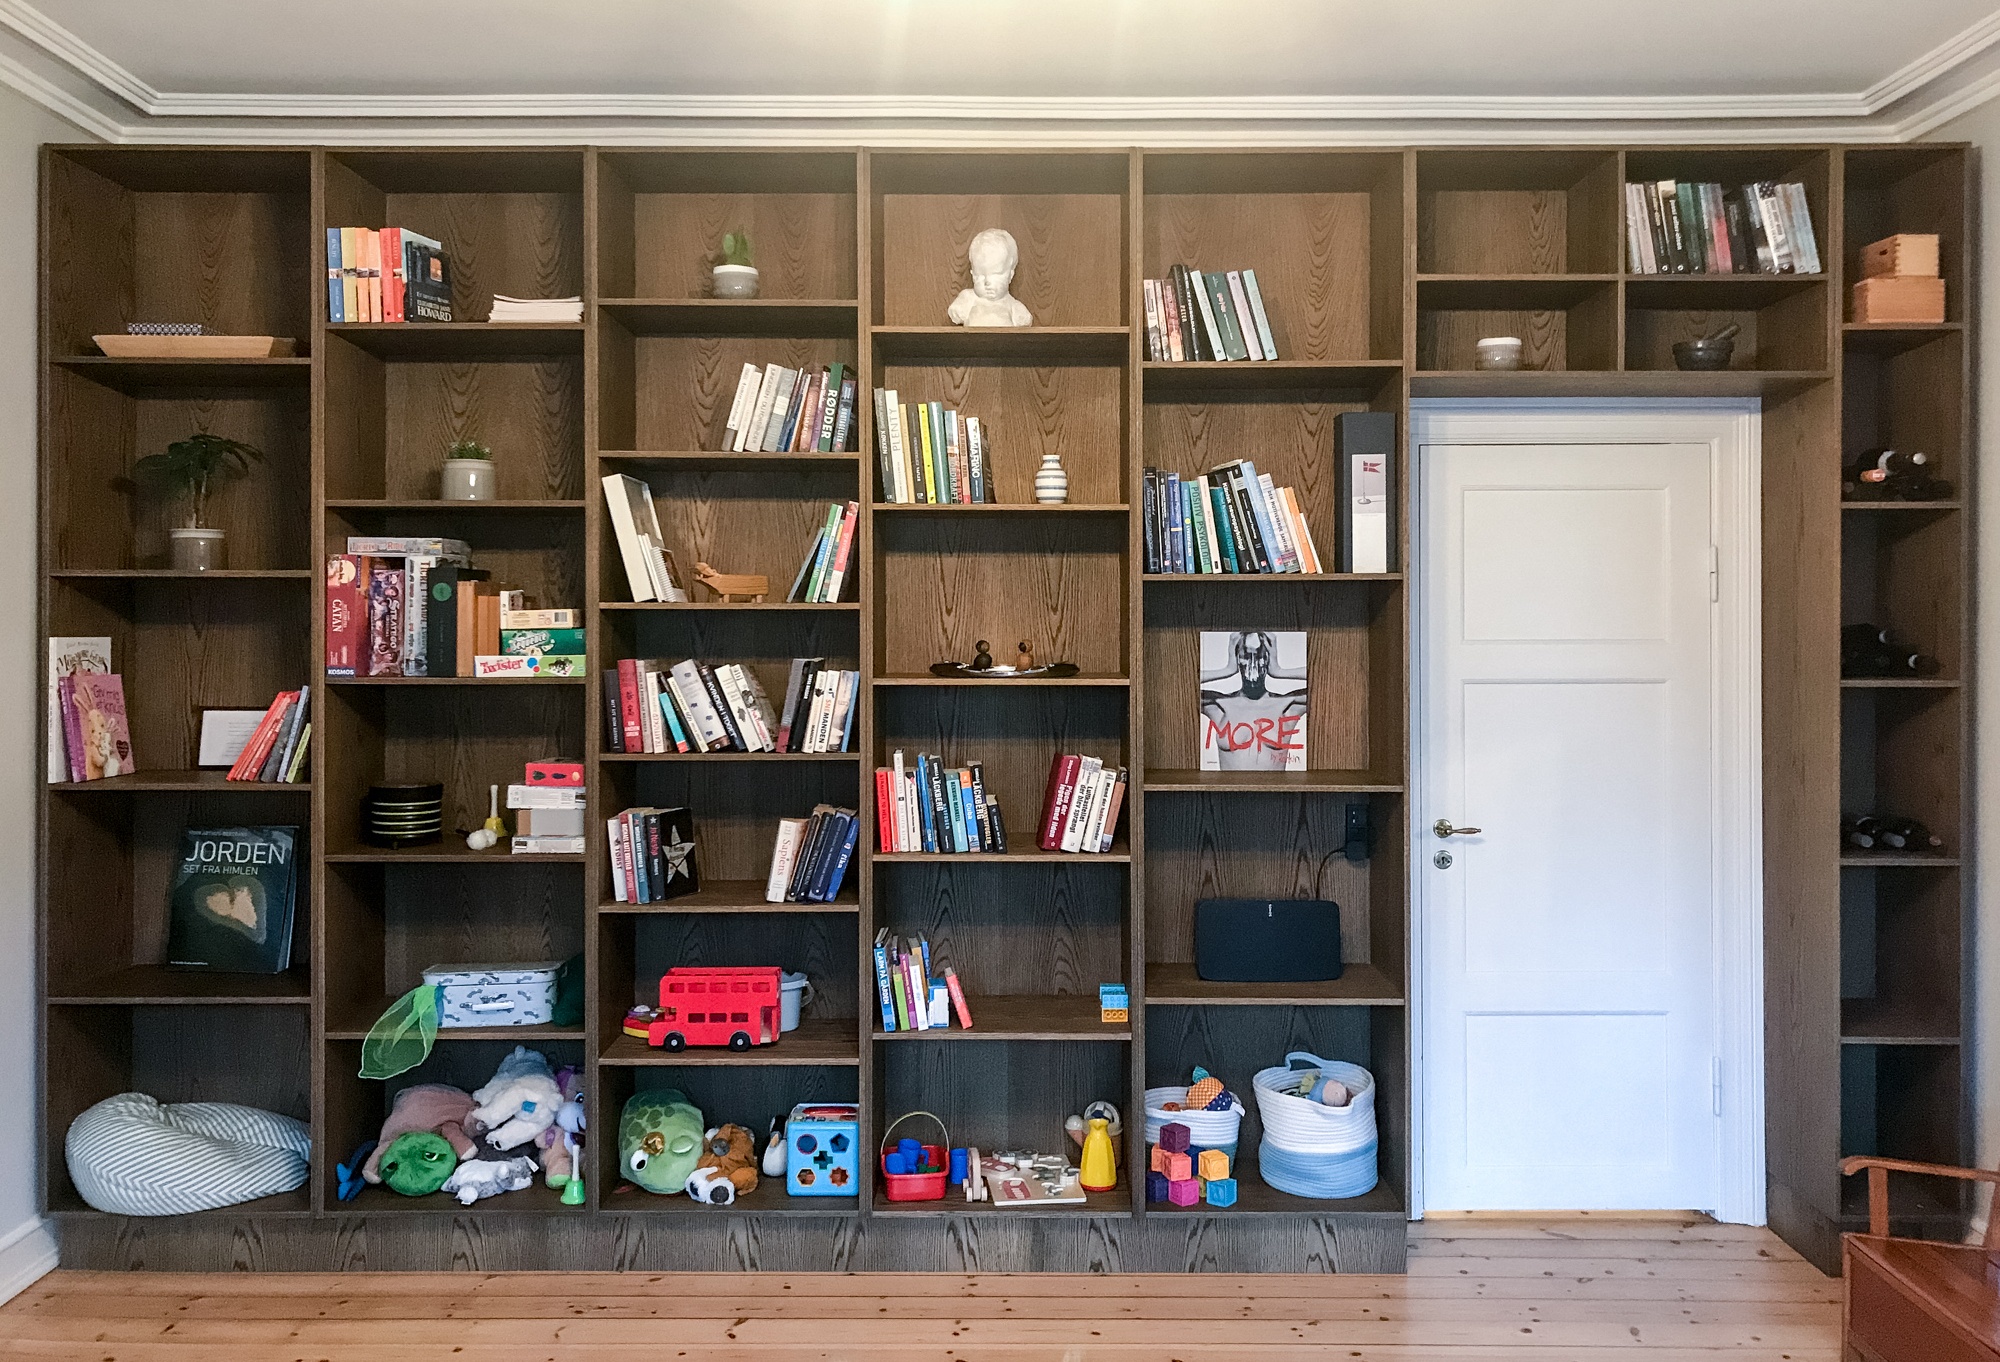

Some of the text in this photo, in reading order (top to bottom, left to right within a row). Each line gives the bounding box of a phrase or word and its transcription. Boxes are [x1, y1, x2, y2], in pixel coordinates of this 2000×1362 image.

[417, 305, 452, 322] HOWARD
[821, 389, 838, 439] RØDDER
[890, 408, 901, 452] PLENTY
[1190, 486, 1210, 566] POSITIV PSYKOLOGI
[1221, 482, 1233, 503] Klinisk
[1228, 504, 1246, 551] neuropsykologi
[1270, 501, 1283, 531] MOTIVERENDE
[332, 598, 342, 632] CATAN
[386, 597, 400, 648] STRATEGO
[328, 668, 354, 676] KOSMOS
[480, 659, 524, 674] Twister
[706, 681, 725, 711] KVINDEN
[721, 714, 736, 738] TOGET
[1205, 715, 1304, 752] MORE
[932, 775, 943, 811] LÄCKBERG
[972, 780, 984, 820] LÄCKBERG
[1060, 784, 1072, 815] Pigen der
[1076, 794, 1084, 808] blev
[1079, 785, 1093, 822] Luftkastellet
[965, 802, 973, 820] Cuba
[1048, 783, 1066, 838] legede med ilden
[1069, 809, 1080, 833] sprængt
[185, 840, 286, 865] JORDEN
[614, 848, 622, 870] TØRST
[777, 838, 791, 876] Sapiens
[837, 853, 847, 869] fika
[182, 864, 259, 876] SET FRA HIMLEN
[879, 978, 890, 1005] GÅRDEN
